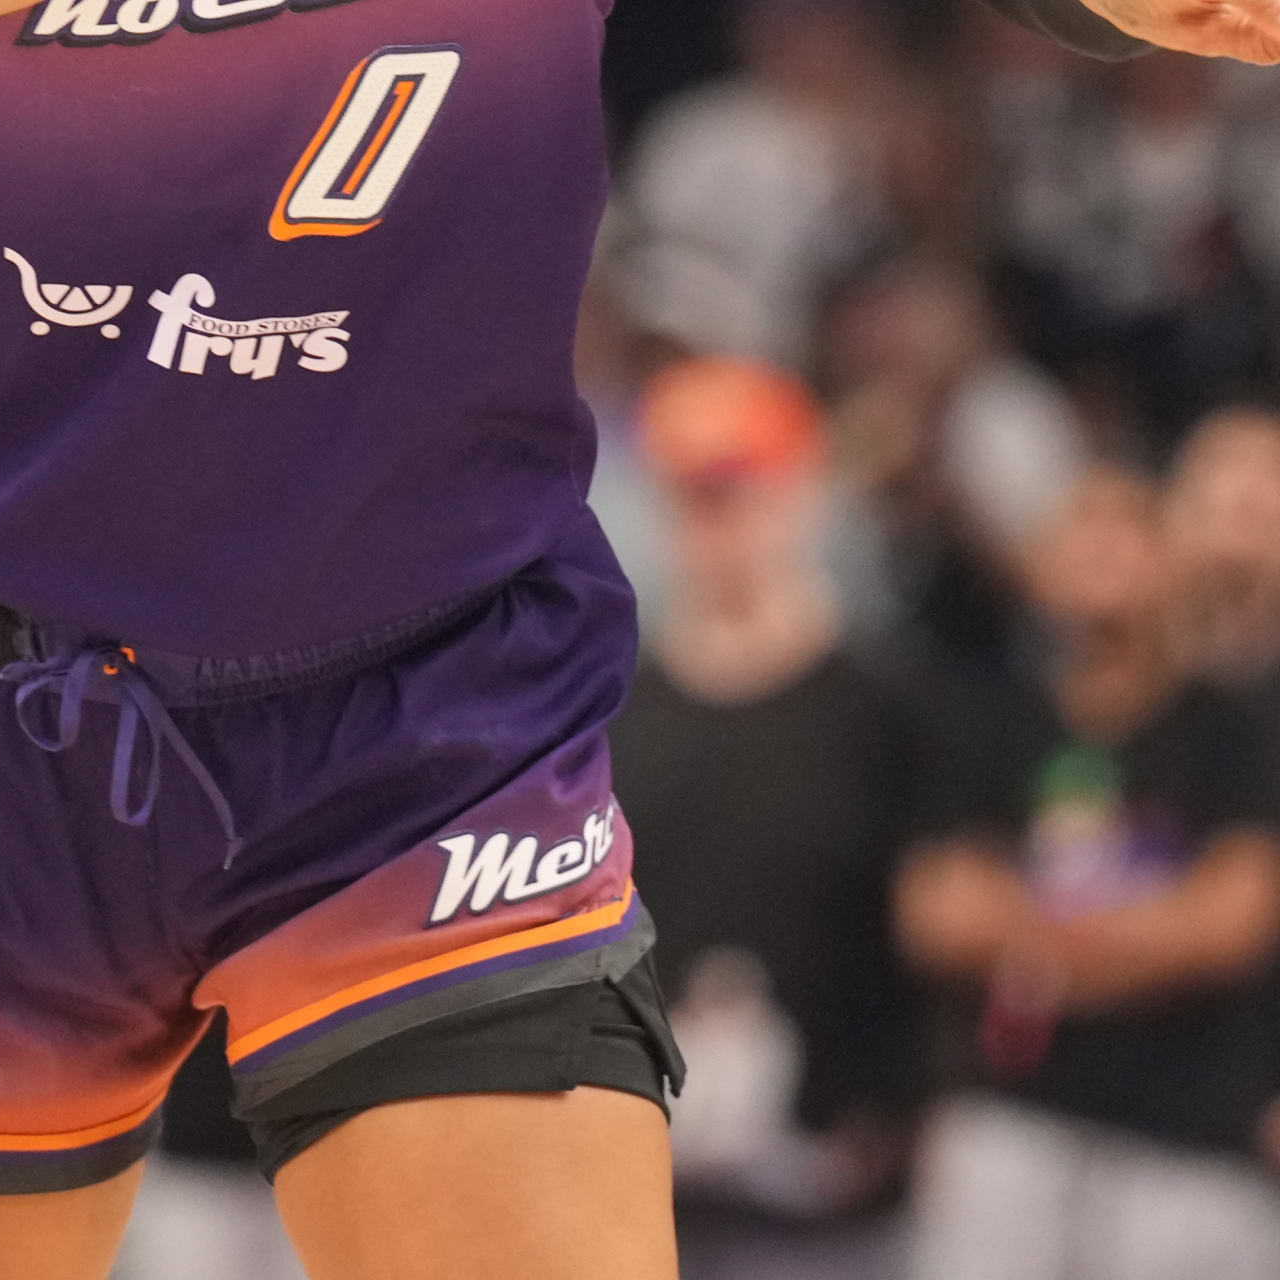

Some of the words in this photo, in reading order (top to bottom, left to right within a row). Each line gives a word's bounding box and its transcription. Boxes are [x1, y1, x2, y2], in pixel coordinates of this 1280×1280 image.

[270, 44, 462, 240] 0
[146, 272, 352, 380] fry's
[187, 313, 250, 336] FOOD
[256, 312, 339, 333] STORES
